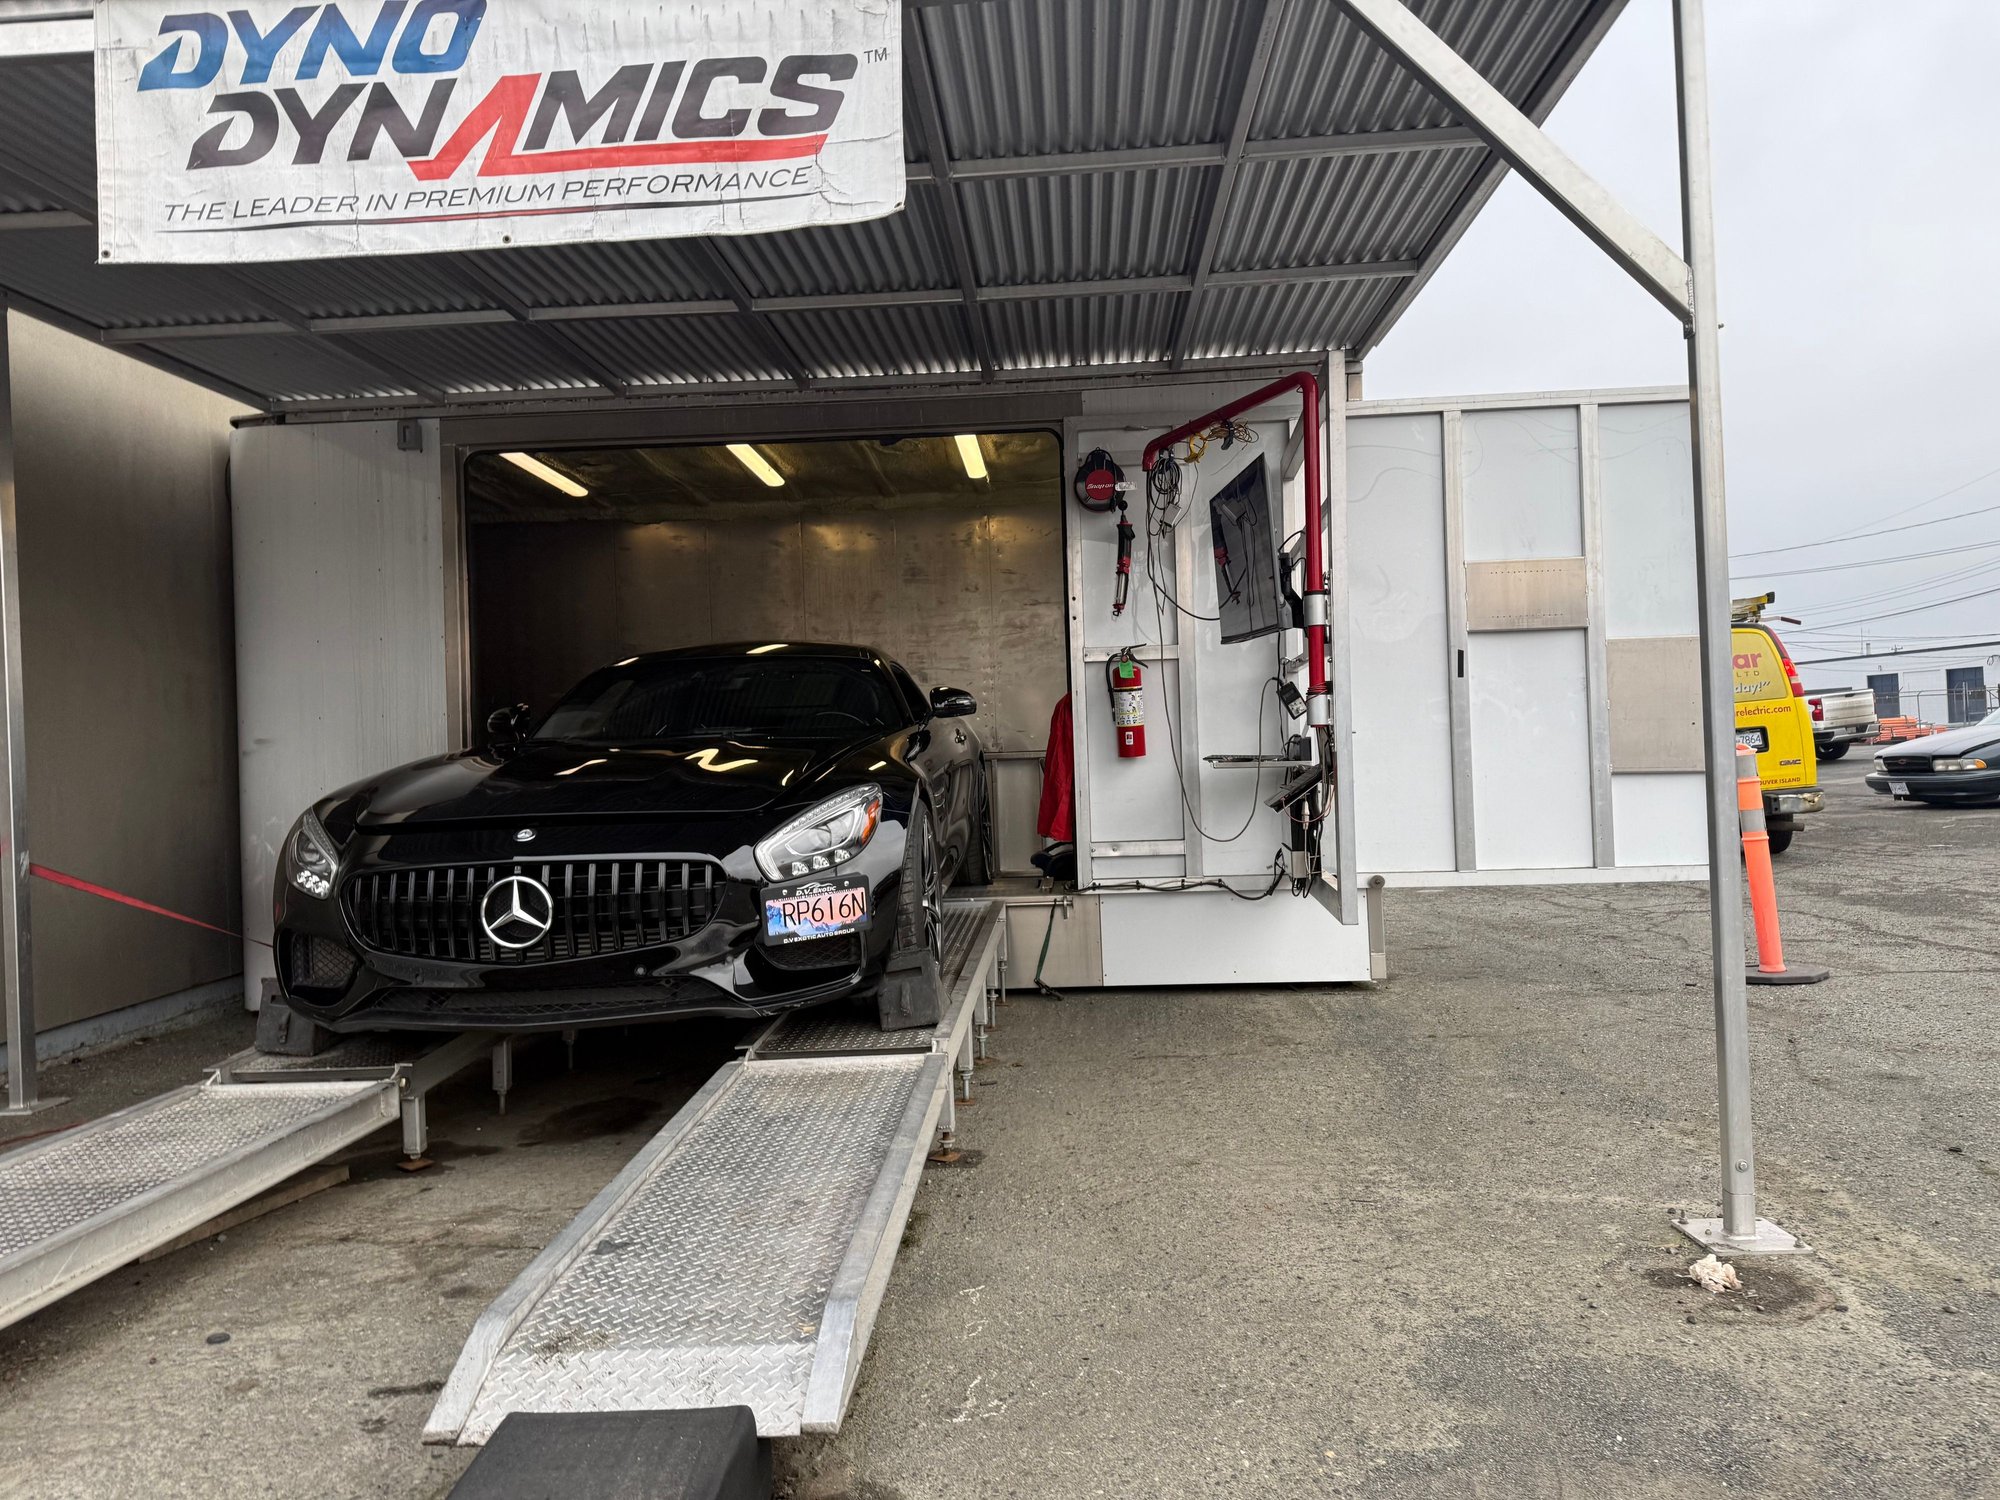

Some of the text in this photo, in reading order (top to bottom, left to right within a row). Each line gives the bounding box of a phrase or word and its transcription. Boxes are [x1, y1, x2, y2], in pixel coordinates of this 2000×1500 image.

[137, 0, 487, 91] DYNO
[186, 54, 858, 180] DYNAMICS
[164, 165, 813, 222] THE LEADER IN PREMIUM PERFORMANCE
[1732, 653, 1762, 669] ar
[782, 891, 865, 928] RP616N
[816, 931, 834, 940] AUTO
[834, 928, 855, 936] GROUP
